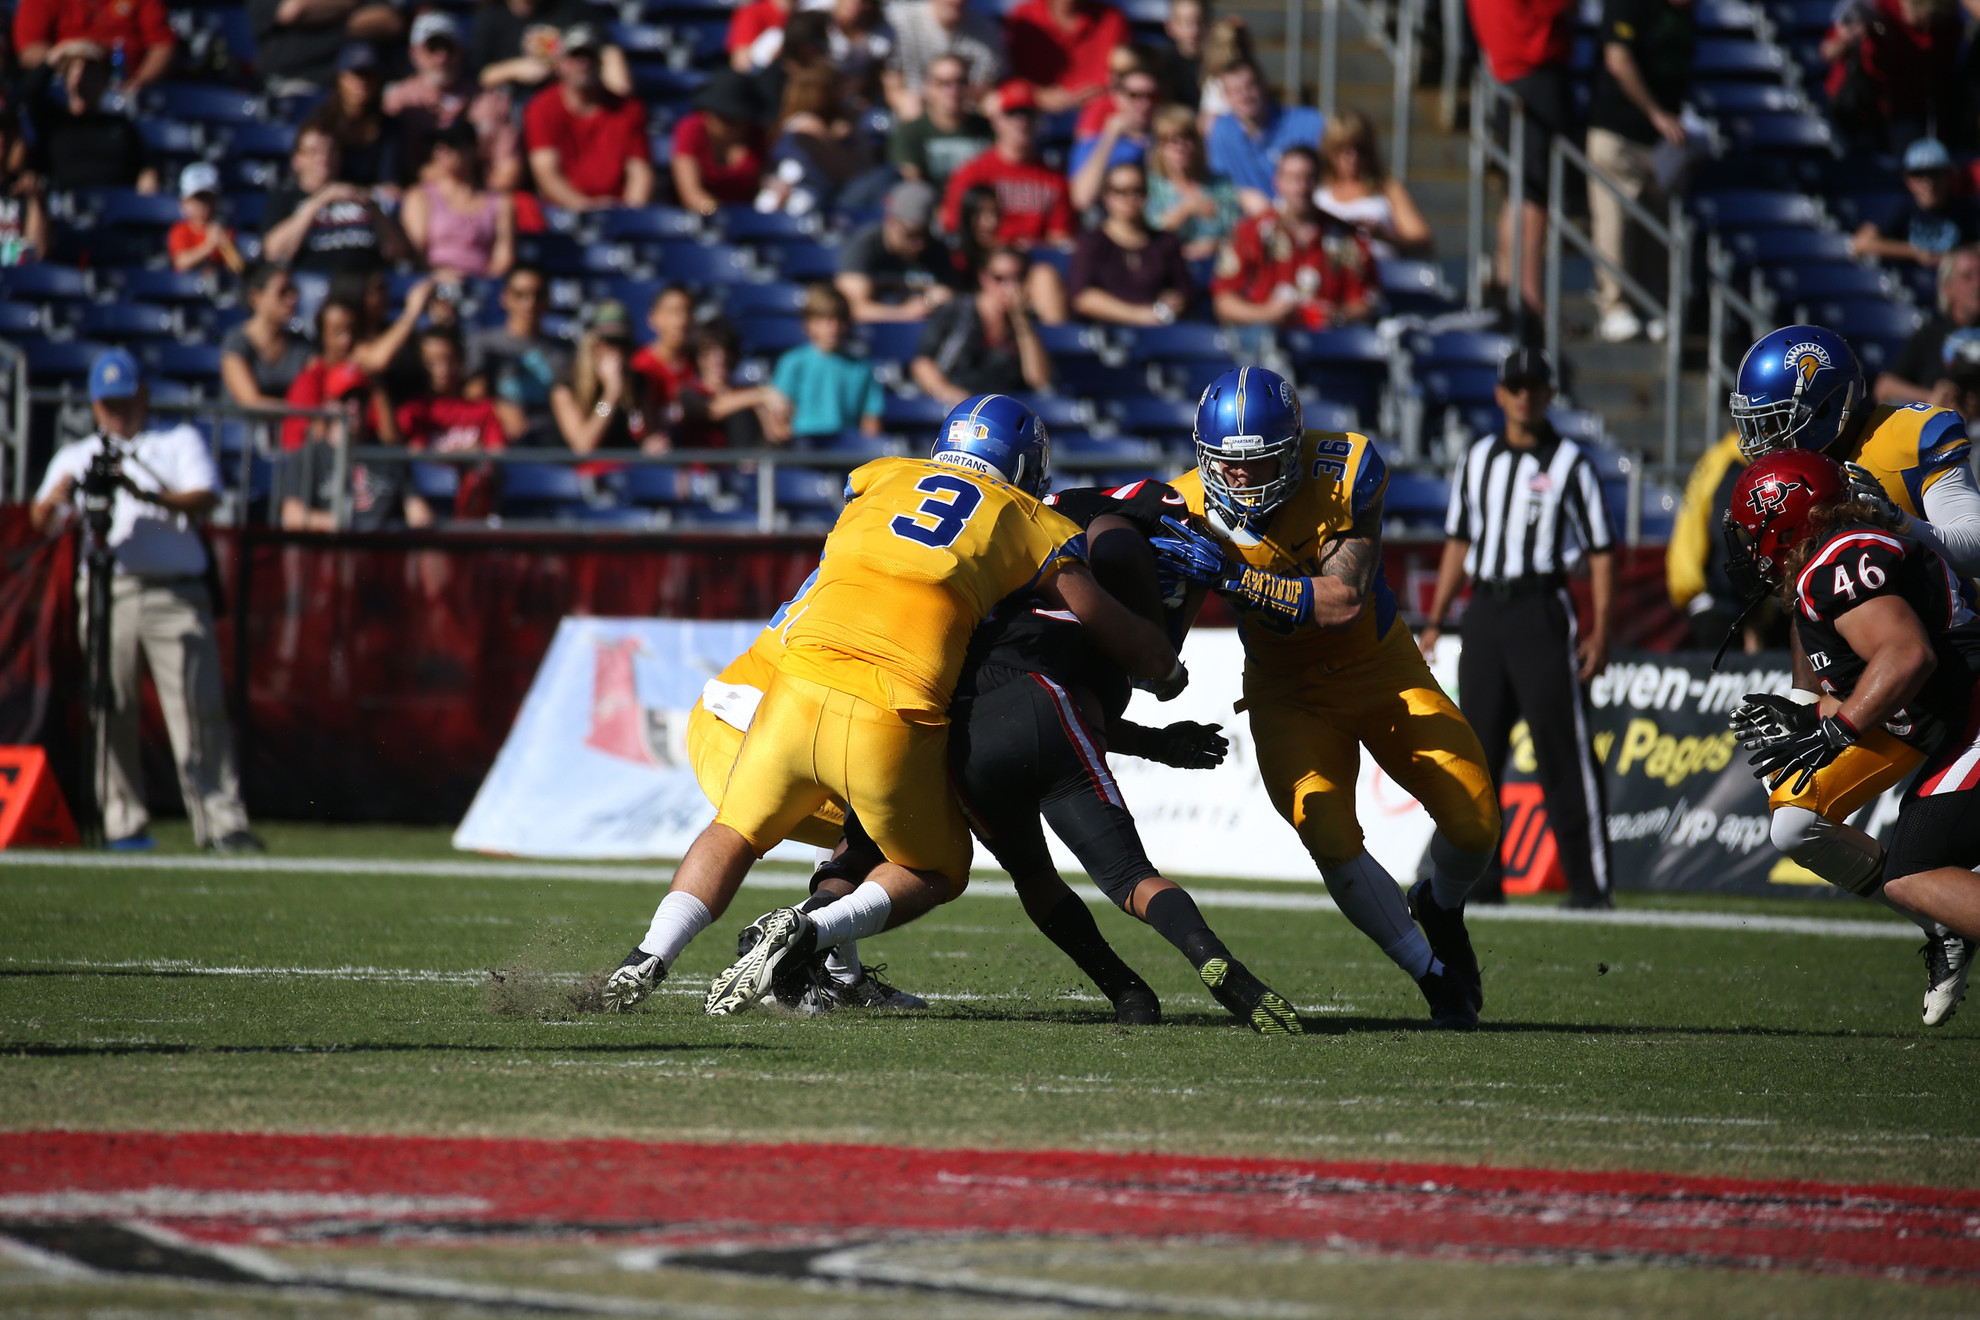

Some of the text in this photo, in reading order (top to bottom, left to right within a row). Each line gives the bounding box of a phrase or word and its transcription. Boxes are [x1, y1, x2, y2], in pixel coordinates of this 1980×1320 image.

[938, 453, 988, 474] SPARTANS
[1312, 439, 1355, 482] 36
[888, 473, 986, 550] 3
[1833, 552, 1886, 601] 46
[1615, 717, 1736, 787] Pages
